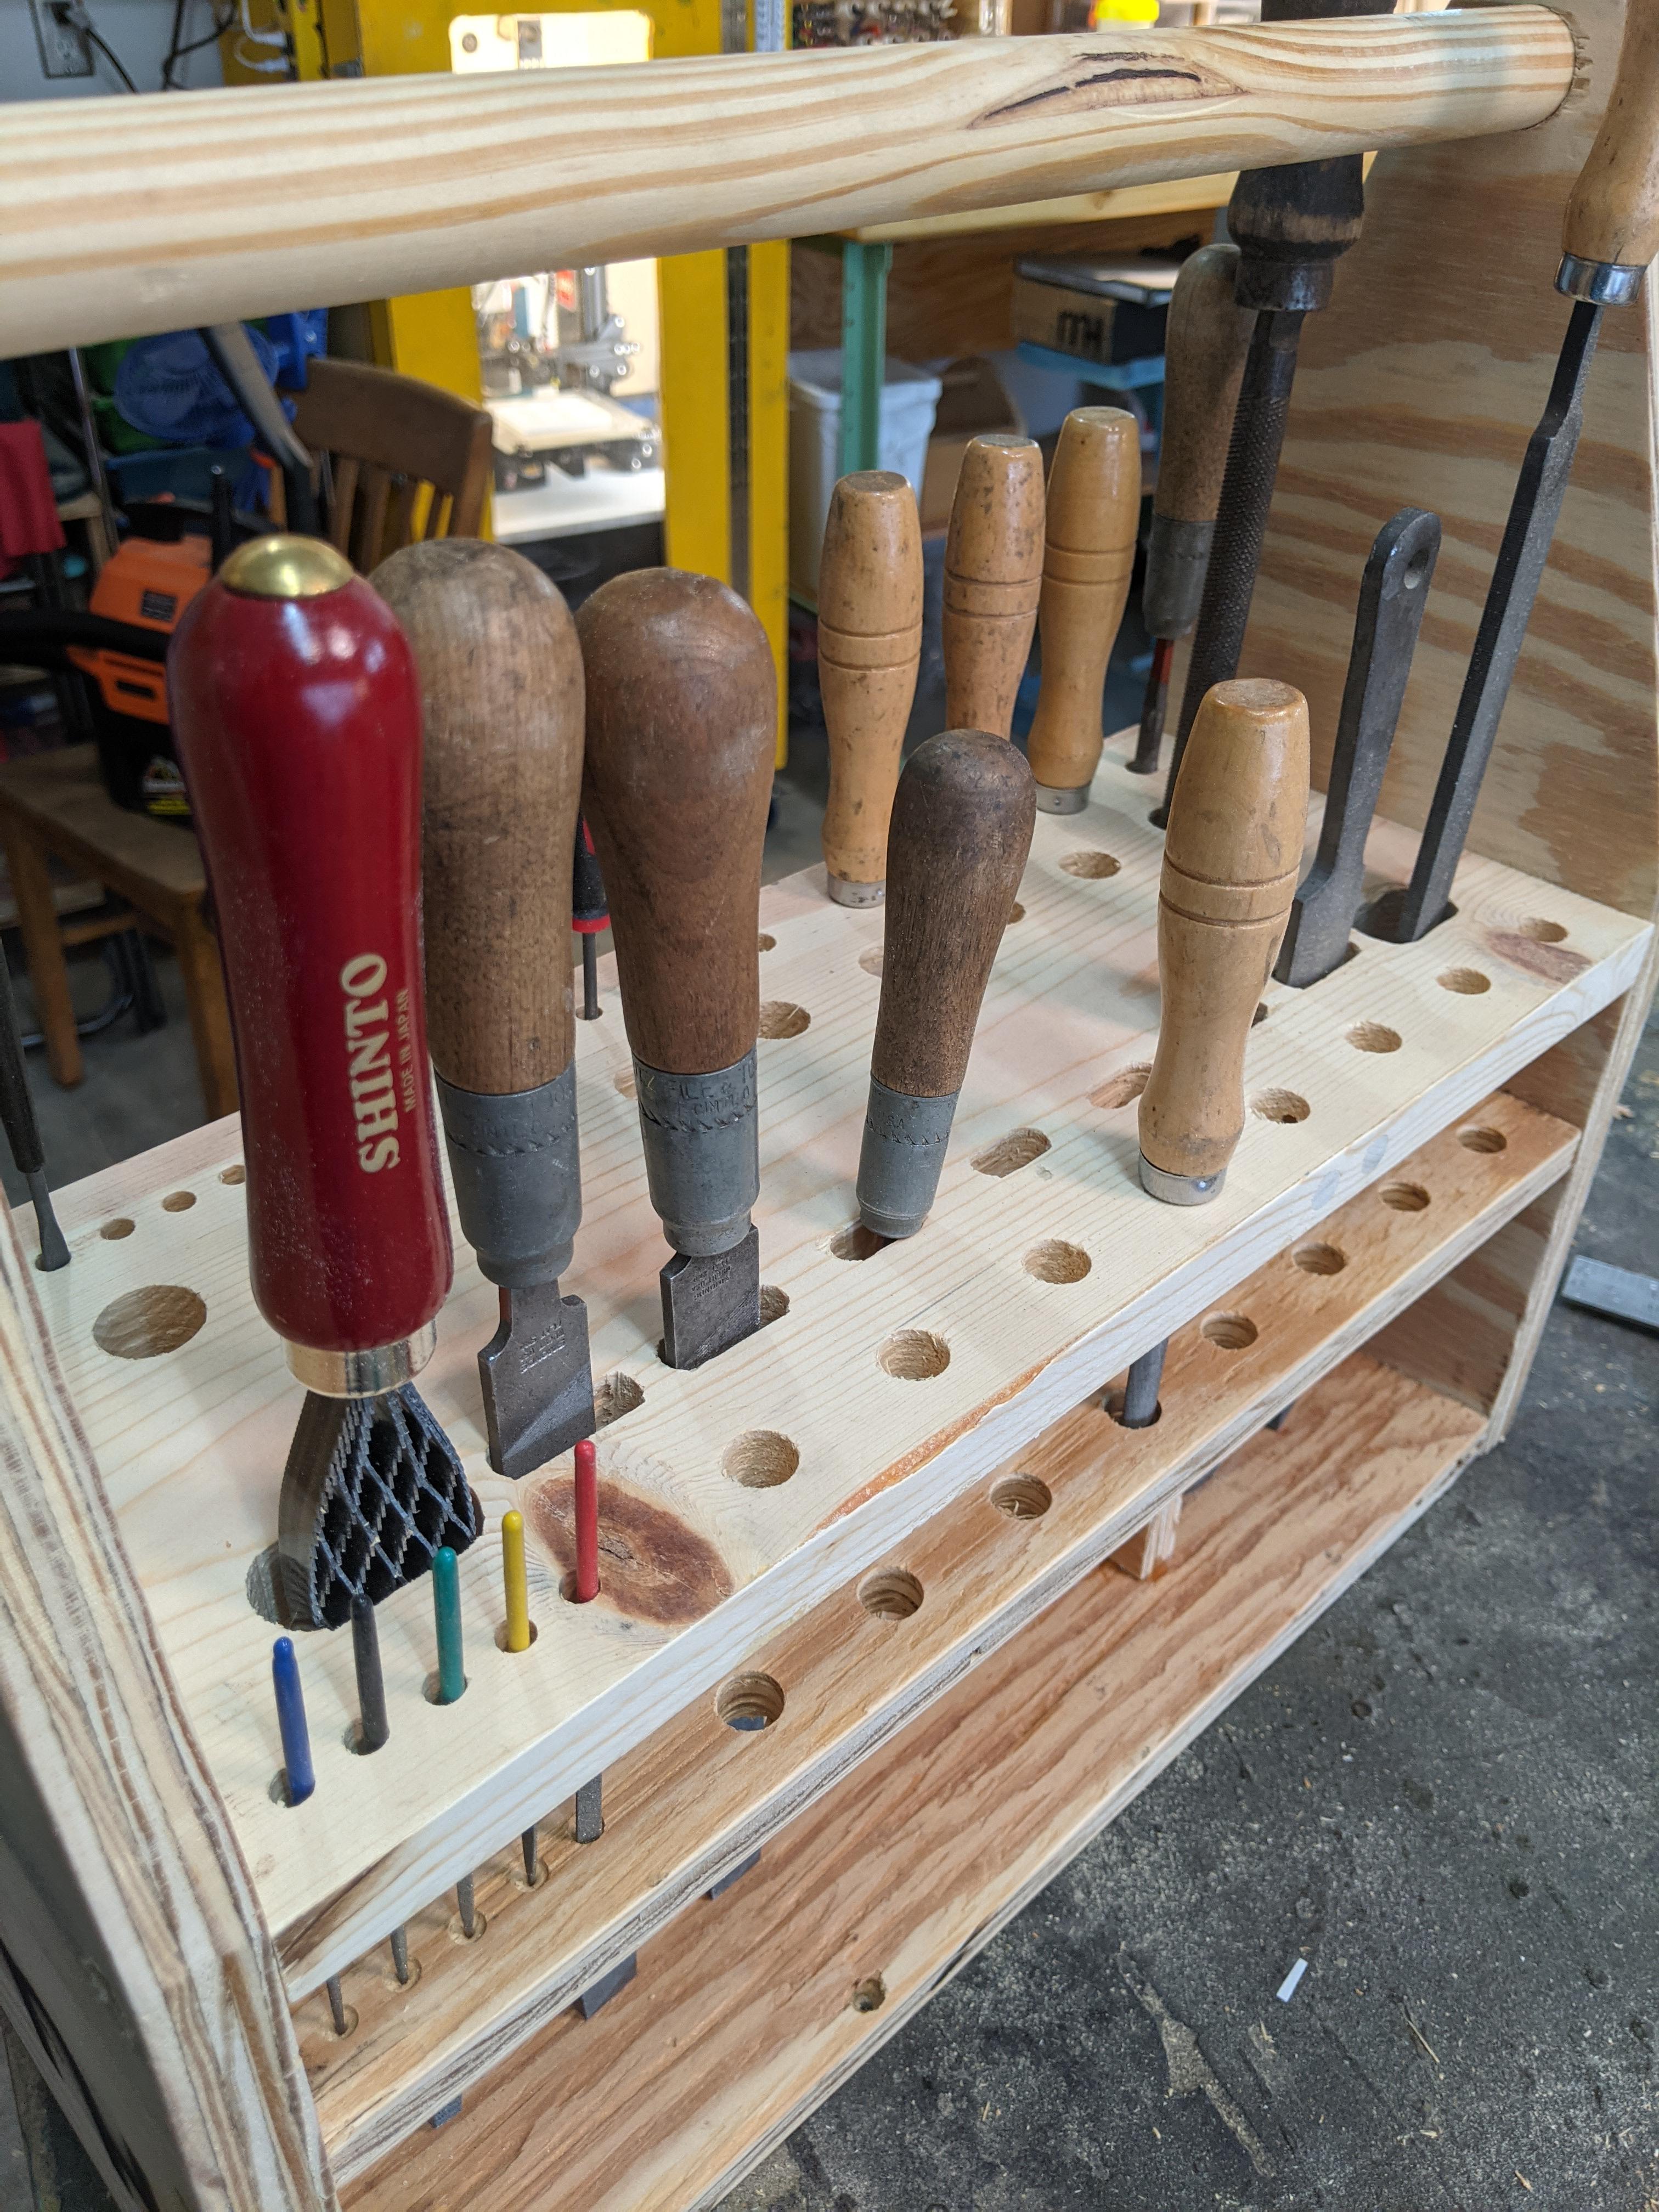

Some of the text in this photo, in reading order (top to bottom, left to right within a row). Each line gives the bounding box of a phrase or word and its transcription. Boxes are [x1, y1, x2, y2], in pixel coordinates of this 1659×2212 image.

[341, 953, 400, 1173] SHINTO
[396, 989, 416, 1113] MADE IN JAPAN
